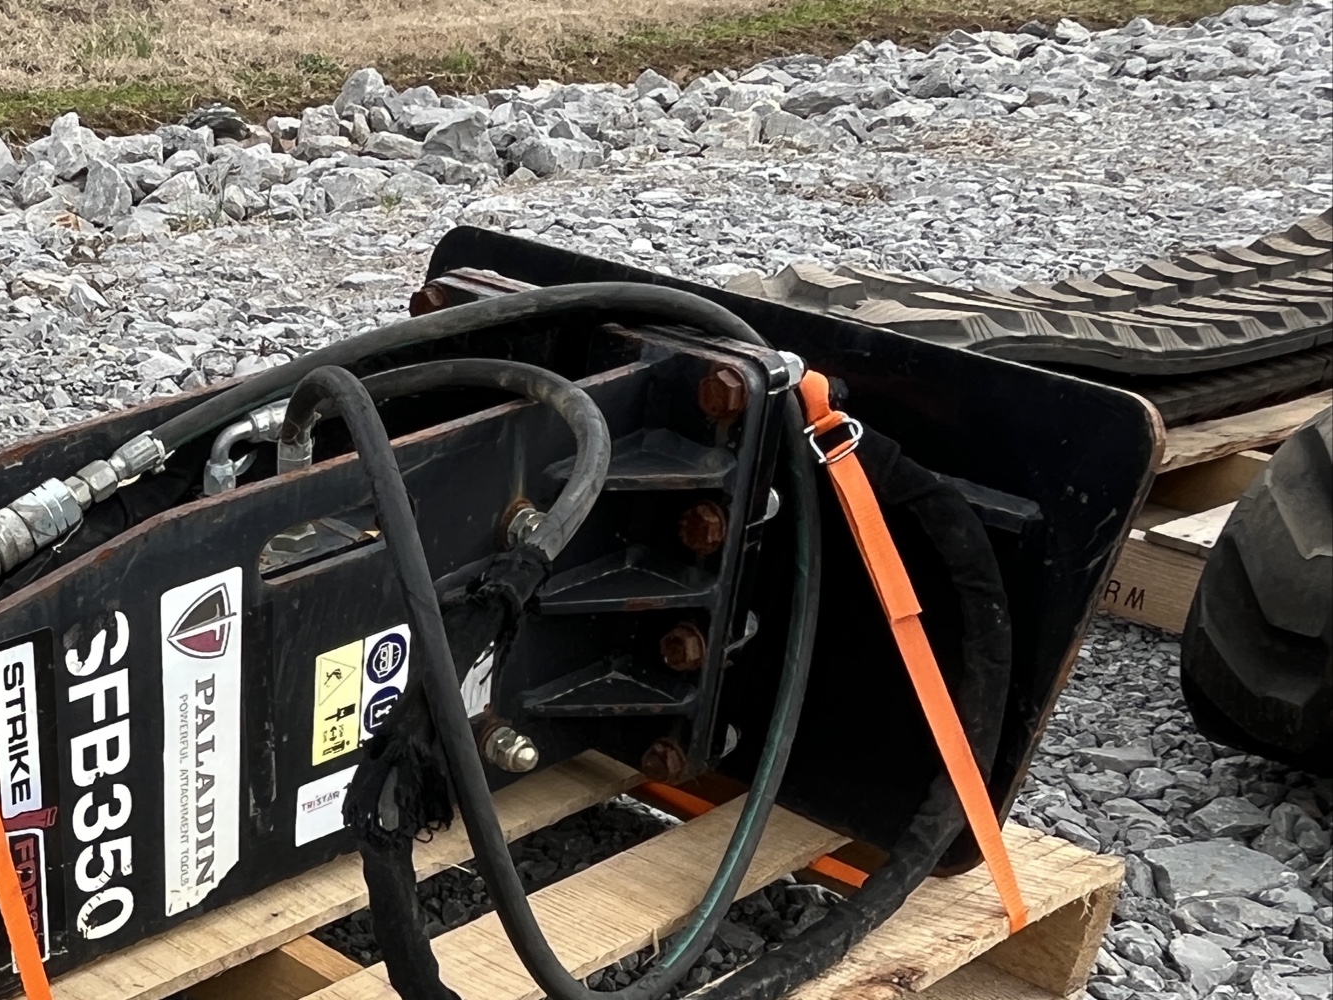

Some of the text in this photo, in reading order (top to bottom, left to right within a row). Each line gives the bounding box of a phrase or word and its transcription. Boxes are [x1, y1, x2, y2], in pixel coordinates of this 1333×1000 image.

[3, 661, 31, 806] STRIKE
[65, 611, 134, 940] SFB350
[179, 693, 189, 887] POWERFUL ATTACHMENT TOOLS
[195, 673, 216, 887] PALADIN
[301, 790, 340, 811] TRISTAR
